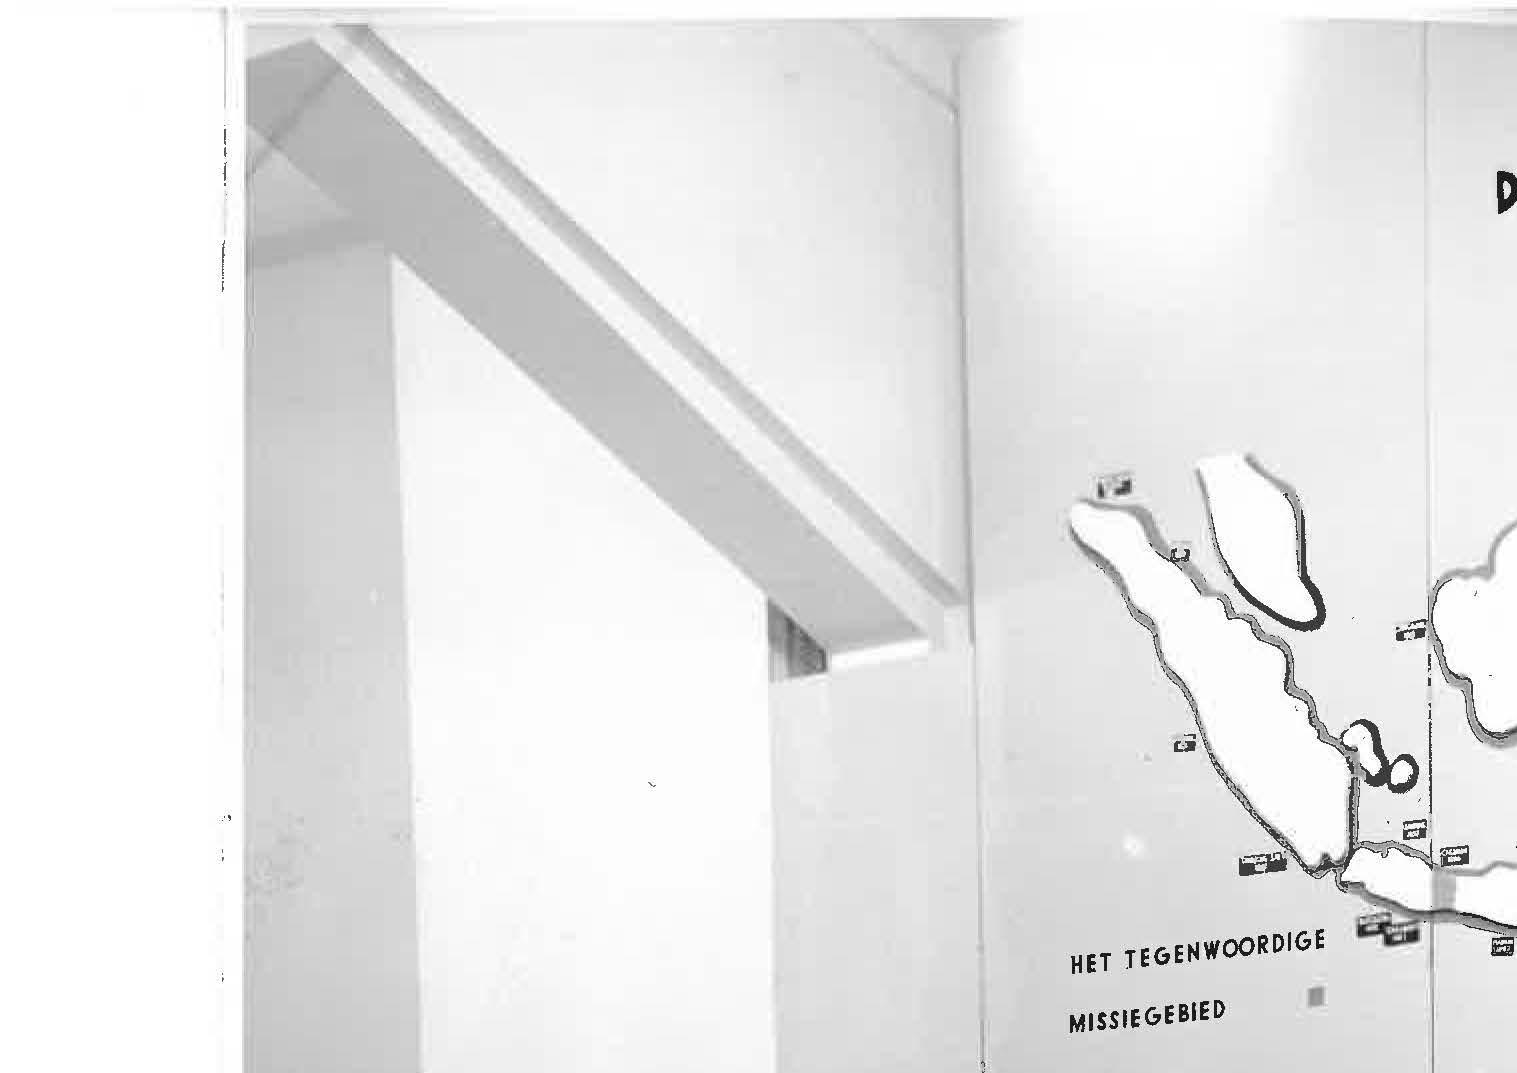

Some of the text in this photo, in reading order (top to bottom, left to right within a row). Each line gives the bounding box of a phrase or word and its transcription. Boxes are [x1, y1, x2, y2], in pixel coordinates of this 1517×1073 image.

[1070, 952, 1112, 975] HET
[1124, 928, 1326, 970] TEGENWOORDIGE
[1069, 999, 1227, 1034] MISSIEGEBIED
